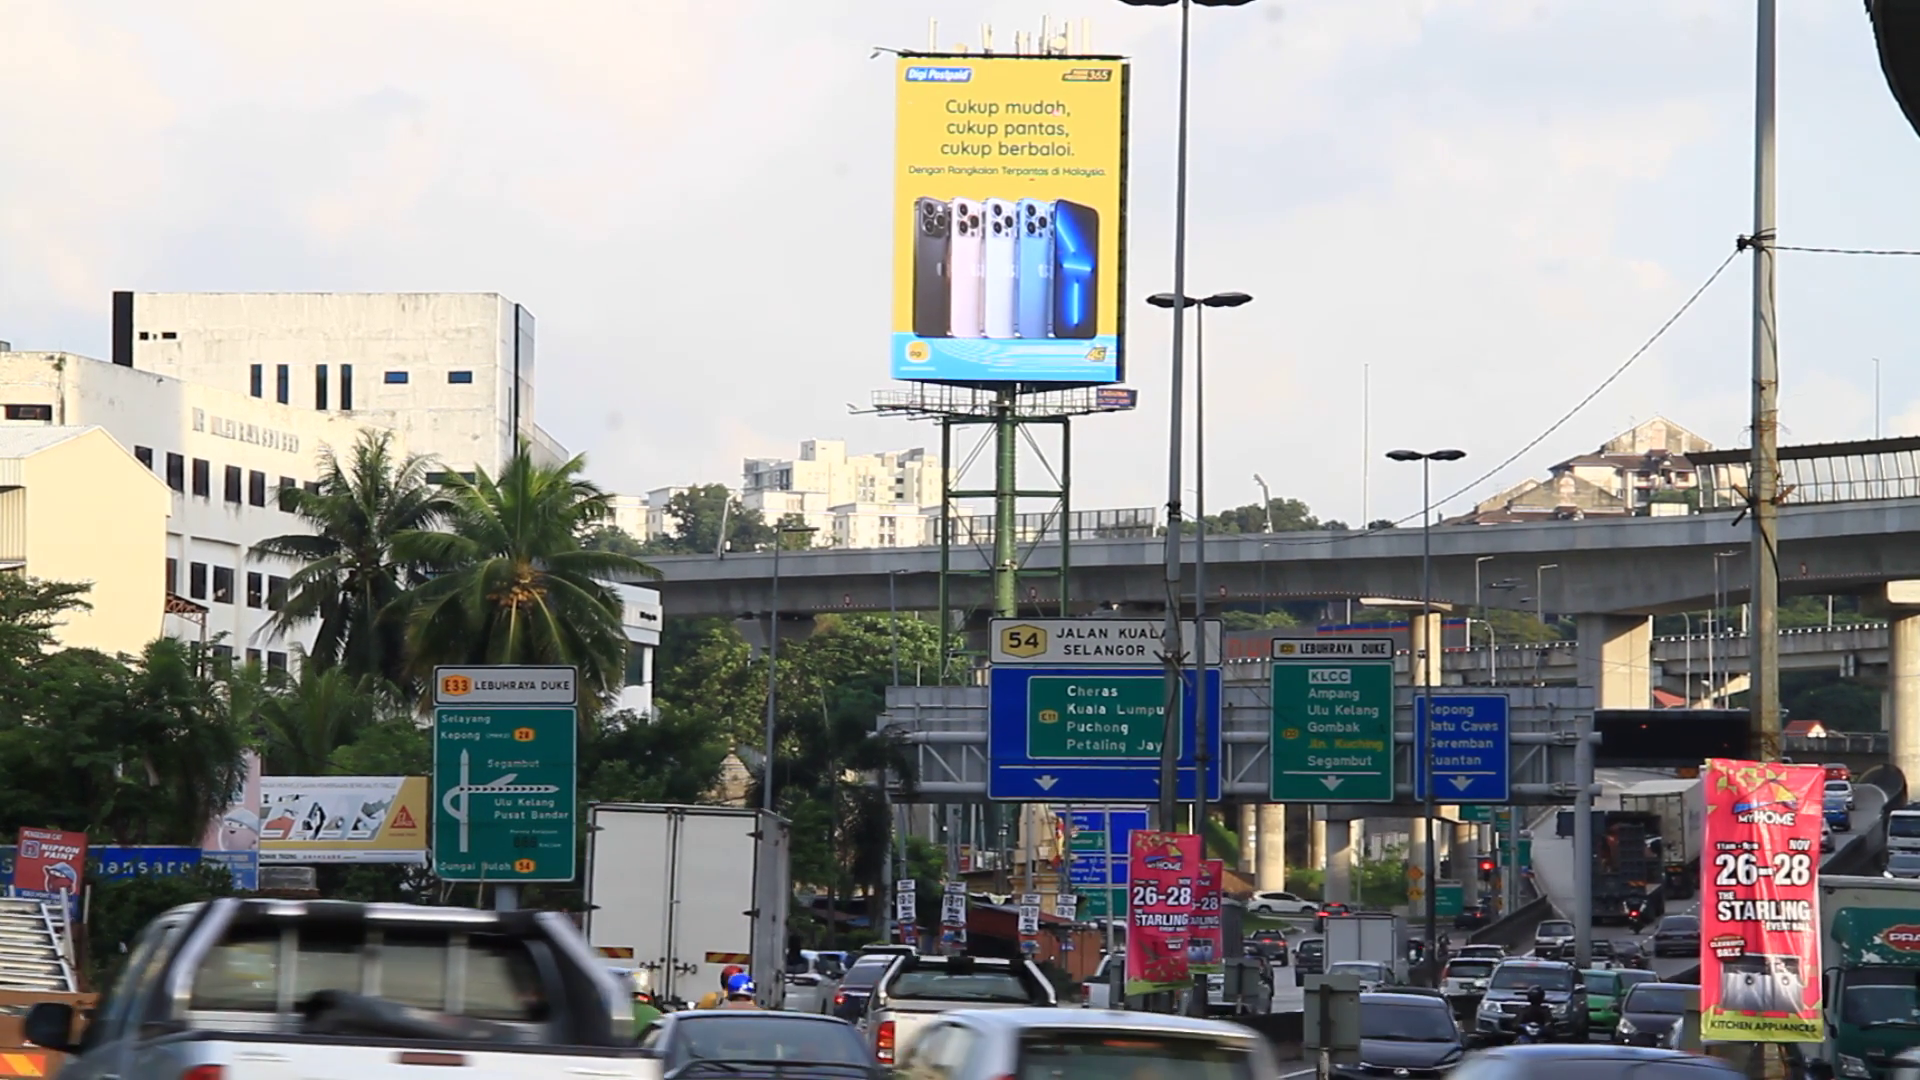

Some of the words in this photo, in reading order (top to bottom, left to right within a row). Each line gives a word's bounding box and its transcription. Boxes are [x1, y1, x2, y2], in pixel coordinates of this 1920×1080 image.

[908, 68, 928, 80] Digi
[929, 68, 970, 81] Postpaid
[1088, 70, 1109, 80] 365
[945, 99, 1000, 117] Cukup
[1005, 99, 1071, 117] mudah,
[946, 120, 999, 138] cukup
[1004, 122, 1070, 138] pantas,
[940, 141, 992, 158] cukup
[998, 141, 1075, 157] berbaloi.
[908, 165, 945, 176] Dengan
[948, 165, 998, 177] Rangkaian
[1002, 166, 1049, 177] Terpantas
[1051, 166, 1060, 175] di
[1062, 167, 1106, 178] Malaysia.
[1009, 631, 1039, 648] 54
[1056, 628, 1108, 639] JALAN
[1064, 644, 1145, 656] SELANGOR
[1300, 643, 1354, 655] LEBUHRAYA
[1361, 643, 1386, 655] DUKE
[1311, 671, 1349, 682] KLCC
[444, 679, 468, 692] E33
[475, 681, 536, 690] LEBUHRAYA
[541, 681, 570, 690] DUKE
[1067, 685, 1118, 697] Cheras
[1308, 688, 1360, 701] Ampang
[1067, 703, 1107, 715] Kuala
[1117, 704, 1165, 717] Lumpu
[1307, 704, 1329, 716] Ulu
[1335, 704, 1379, 718] Kelang
[441, 714, 491, 724] Selayang
[1067, 722, 1129, 735] Puchong
[1307, 721, 1360, 733] Gombak
[1431, 720, 1456, 731] atu
[1461, 720, 1499, 732] Caves
[441, 731, 481, 741] Kepong
[1067, 739, 1126, 753] Petaling
[1137, 740, 1163, 753] Jay
[1334, 739, 1384, 752] Kuching
[487, 760, 540, 769] Segambut
[1307, 755, 1372, 769] Segambut
[494, 798, 513, 807] Ulu
[518, 798, 555, 808] Kelang
[494, 811, 526, 819] Pusat
[531, 811, 569, 819] Bandar
[41, 843, 81, 854] NIPPON
[1788, 839, 1811, 850] NOV
[43, 851, 75, 861] PAINT
[1, 857, 14, 875] S
[440, 862, 476, 872] Sungai
[482, 862, 511, 871] Buloh
[1715, 853, 1811, 886] 26-28
[1133, 886, 1191, 906] 26-28
[1718, 900, 1811, 921] STARLING
[1135, 914, 1189, 926] STARLING
[1711, 1021, 1751, 1031] KITCHEN
[1755, 1022, 1817, 1033] APPLIANCES
